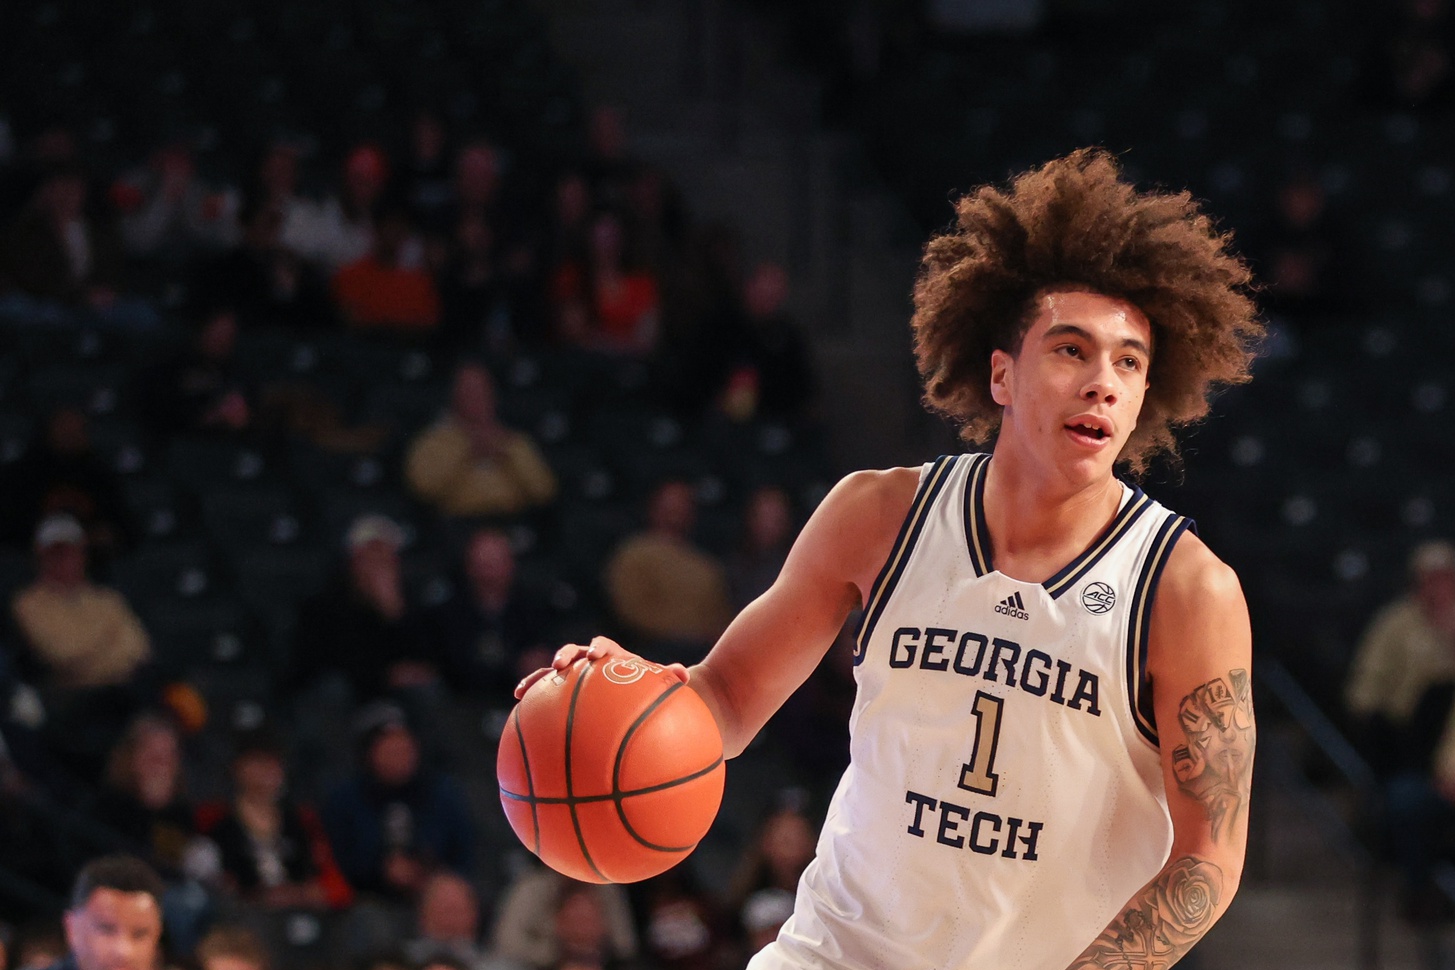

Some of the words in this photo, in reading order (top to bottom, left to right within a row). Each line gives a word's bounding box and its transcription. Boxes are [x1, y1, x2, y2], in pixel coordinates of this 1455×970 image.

[995, 604, 1029, 621] adidas
[1086, 591, 1115, 605] ACC
[889, 627, 1101, 716] GEORGIA
[957, 690, 1005, 797] 1
[905, 790, 1044, 861] TECH
